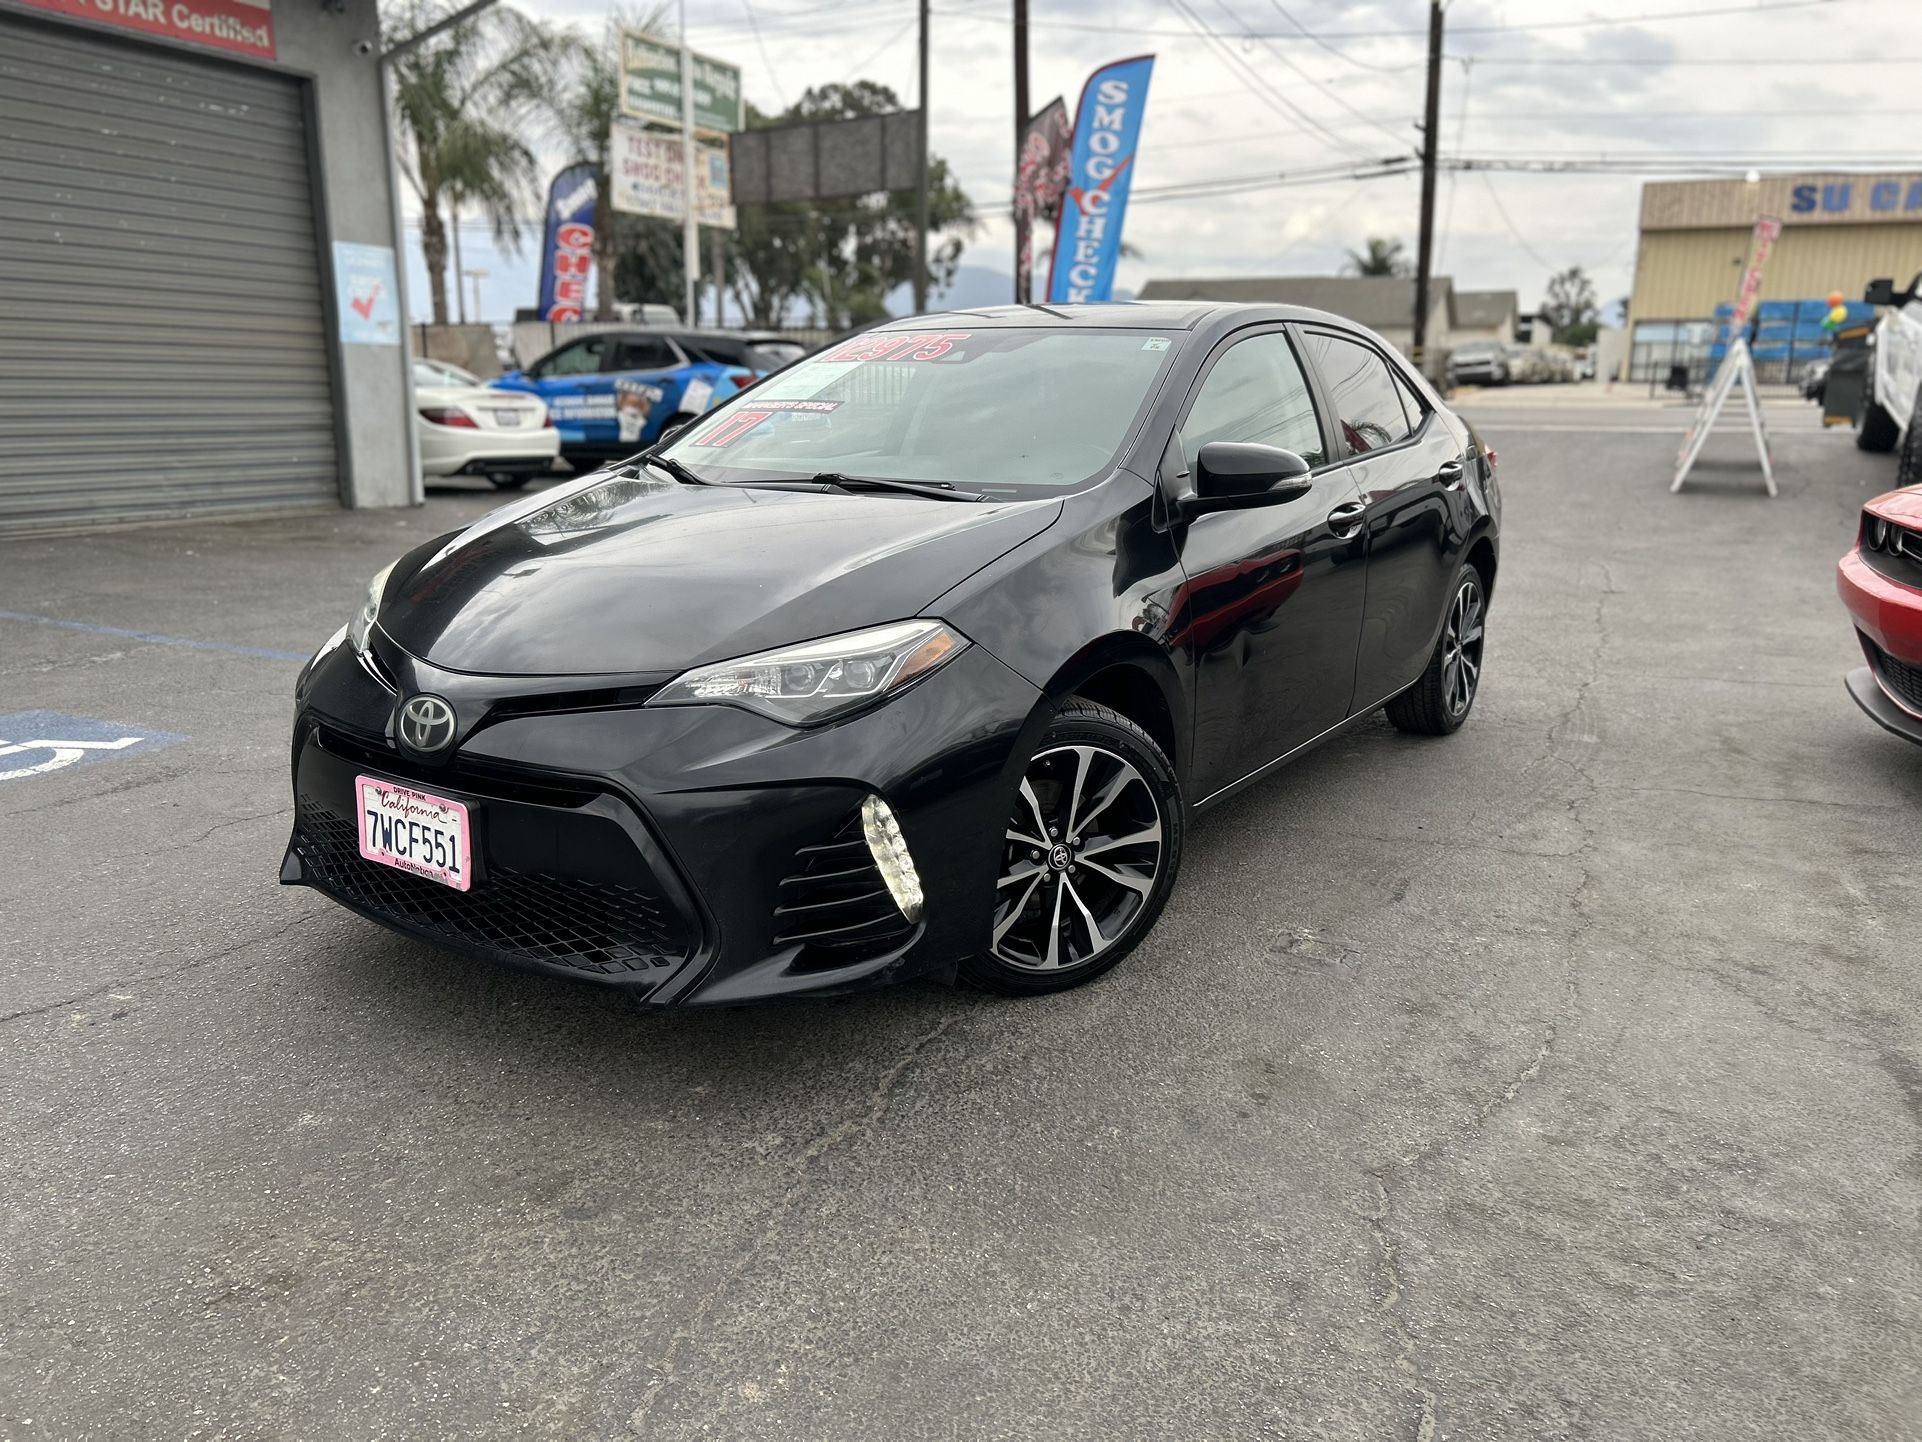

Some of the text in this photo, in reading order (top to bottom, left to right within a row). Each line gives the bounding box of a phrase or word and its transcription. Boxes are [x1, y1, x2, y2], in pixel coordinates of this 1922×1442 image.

[171, 5, 269, 48] Certified
[1086, 79, 1129, 180] SMOG
[1791, 182, 1852, 214] SU
[695, 411, 774, 447] 17
[381, 790, 448, 824] California
[393, 786, 427, 801] DRIVE PINK
[366, 809, 460, 874] 7WCF551
